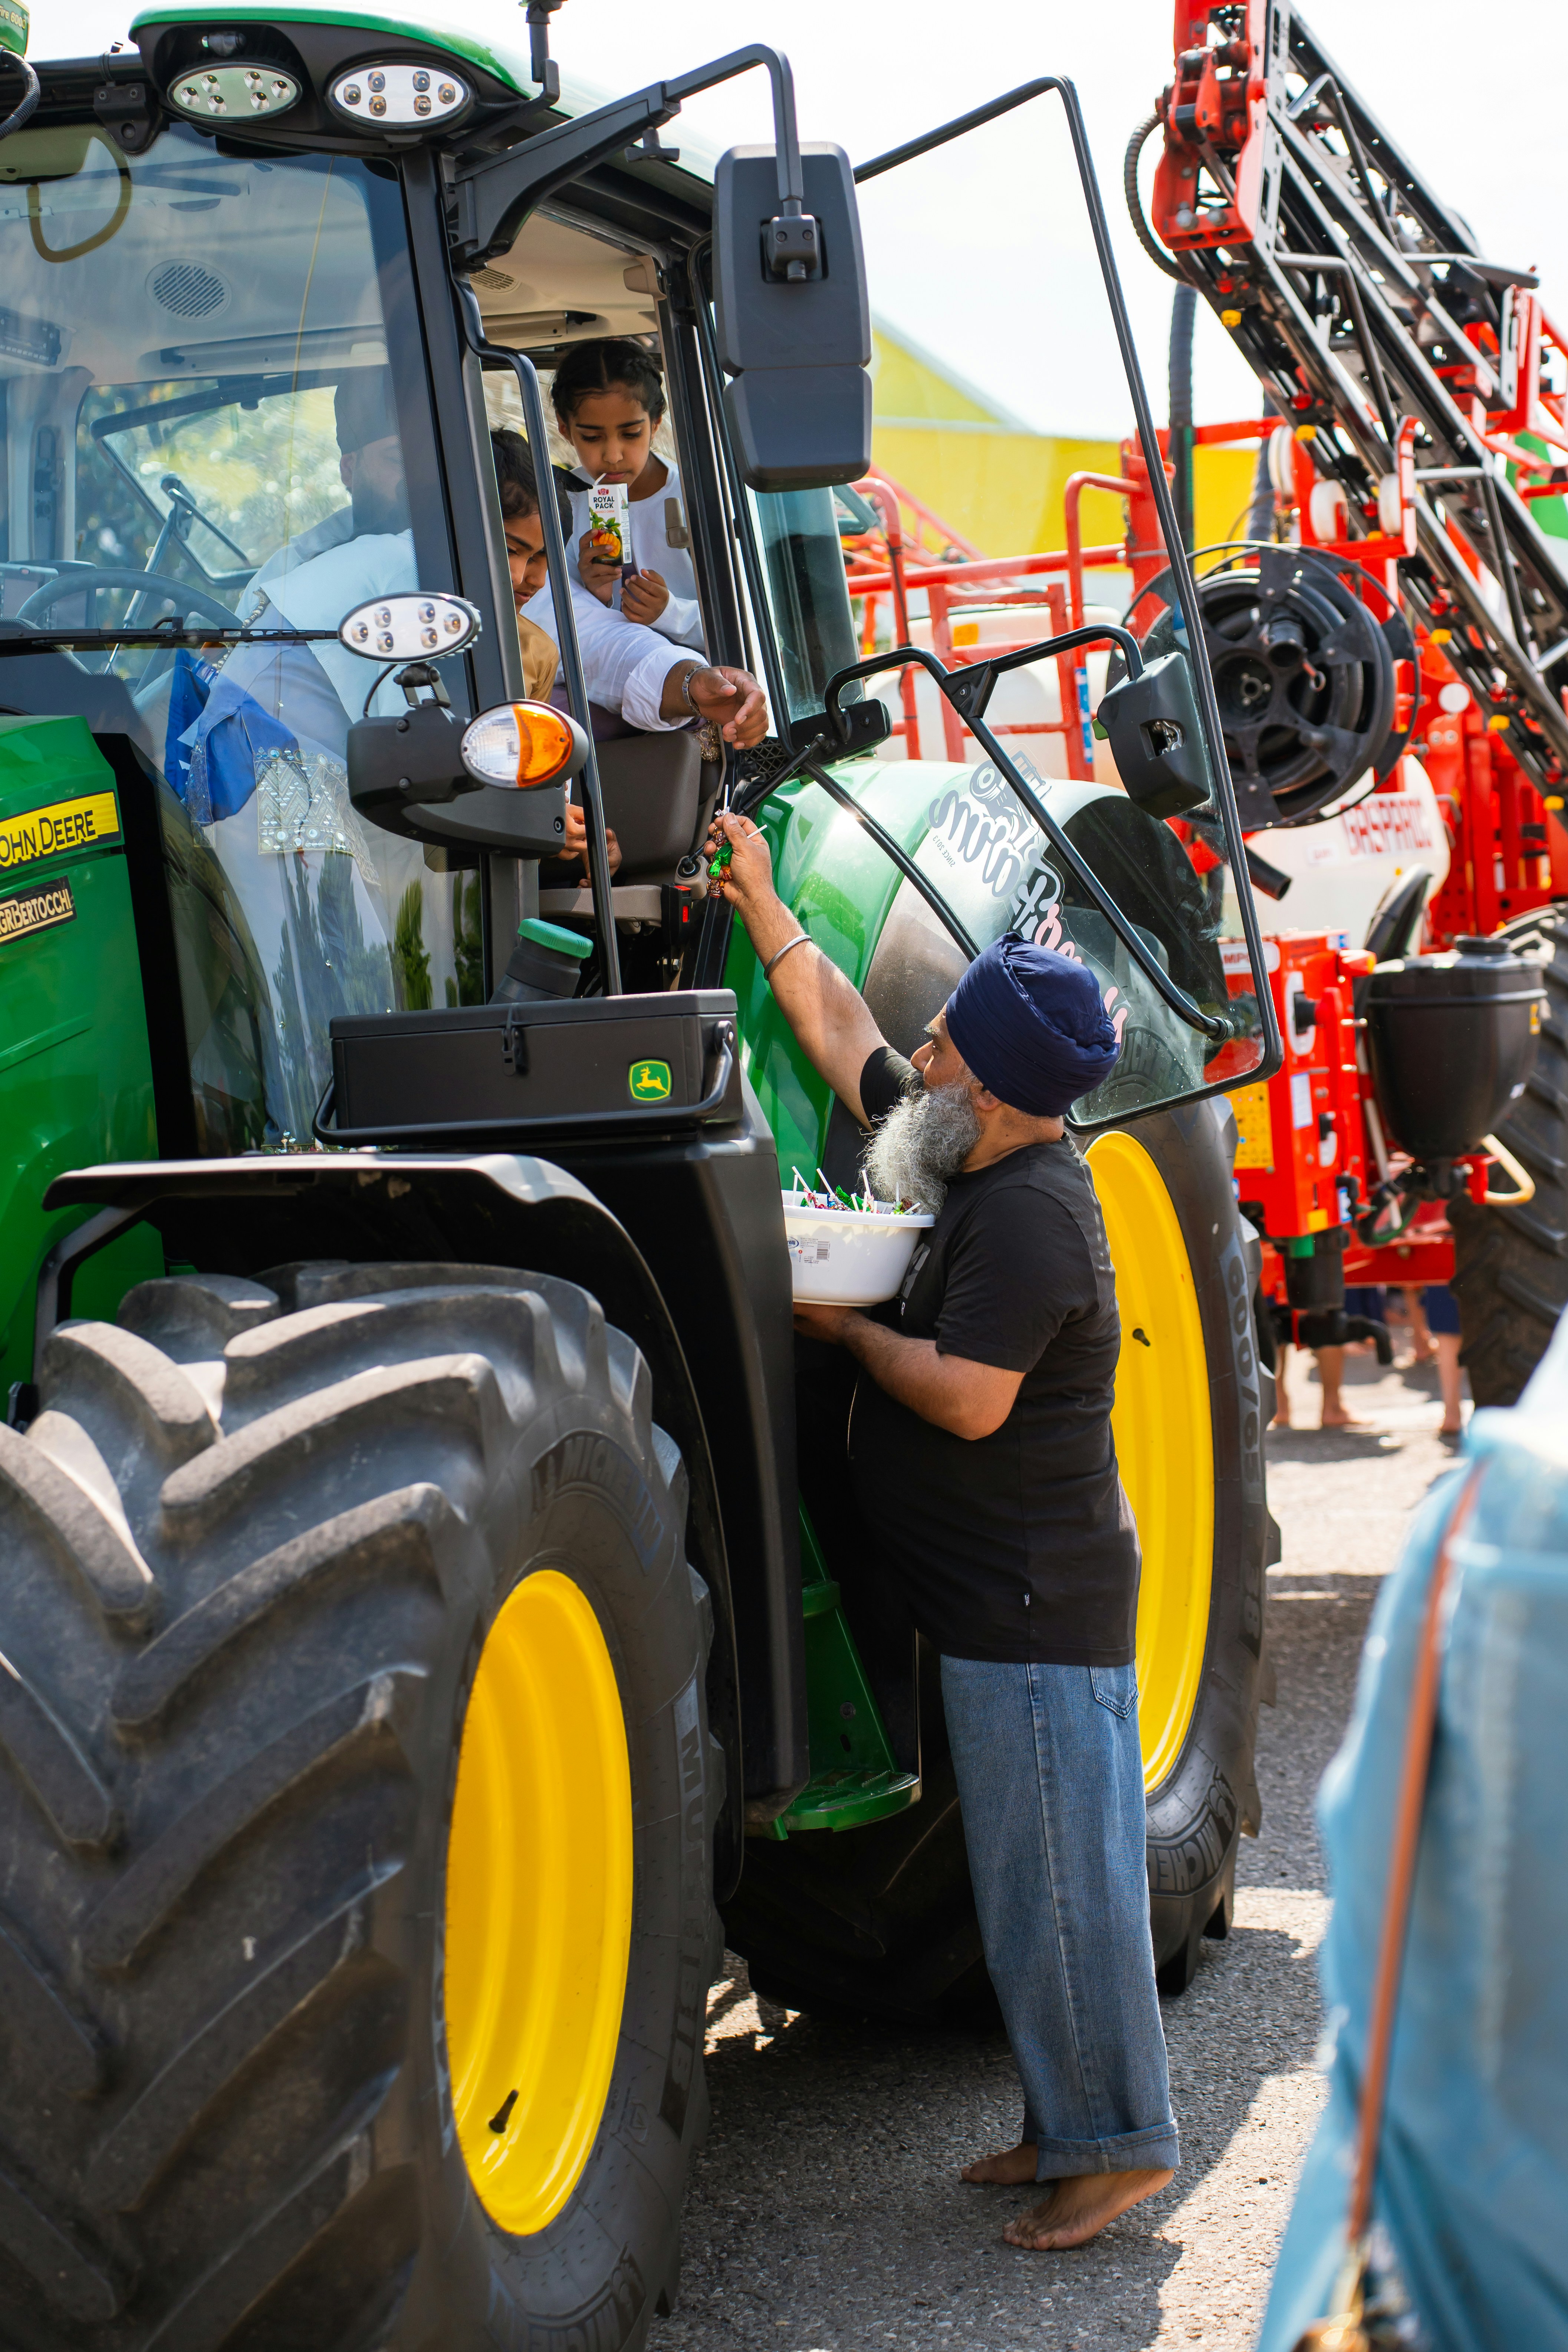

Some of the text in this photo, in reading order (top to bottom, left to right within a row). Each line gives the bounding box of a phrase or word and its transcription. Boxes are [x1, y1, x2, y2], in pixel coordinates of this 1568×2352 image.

[10, 11, 26, 30] 6000
[0, 810, 96, 862] OHN DEERE
[0, 889, 71, 934] GRIBERTOCCHI
[1145, 1814, 1224, 1891] MICHEL
